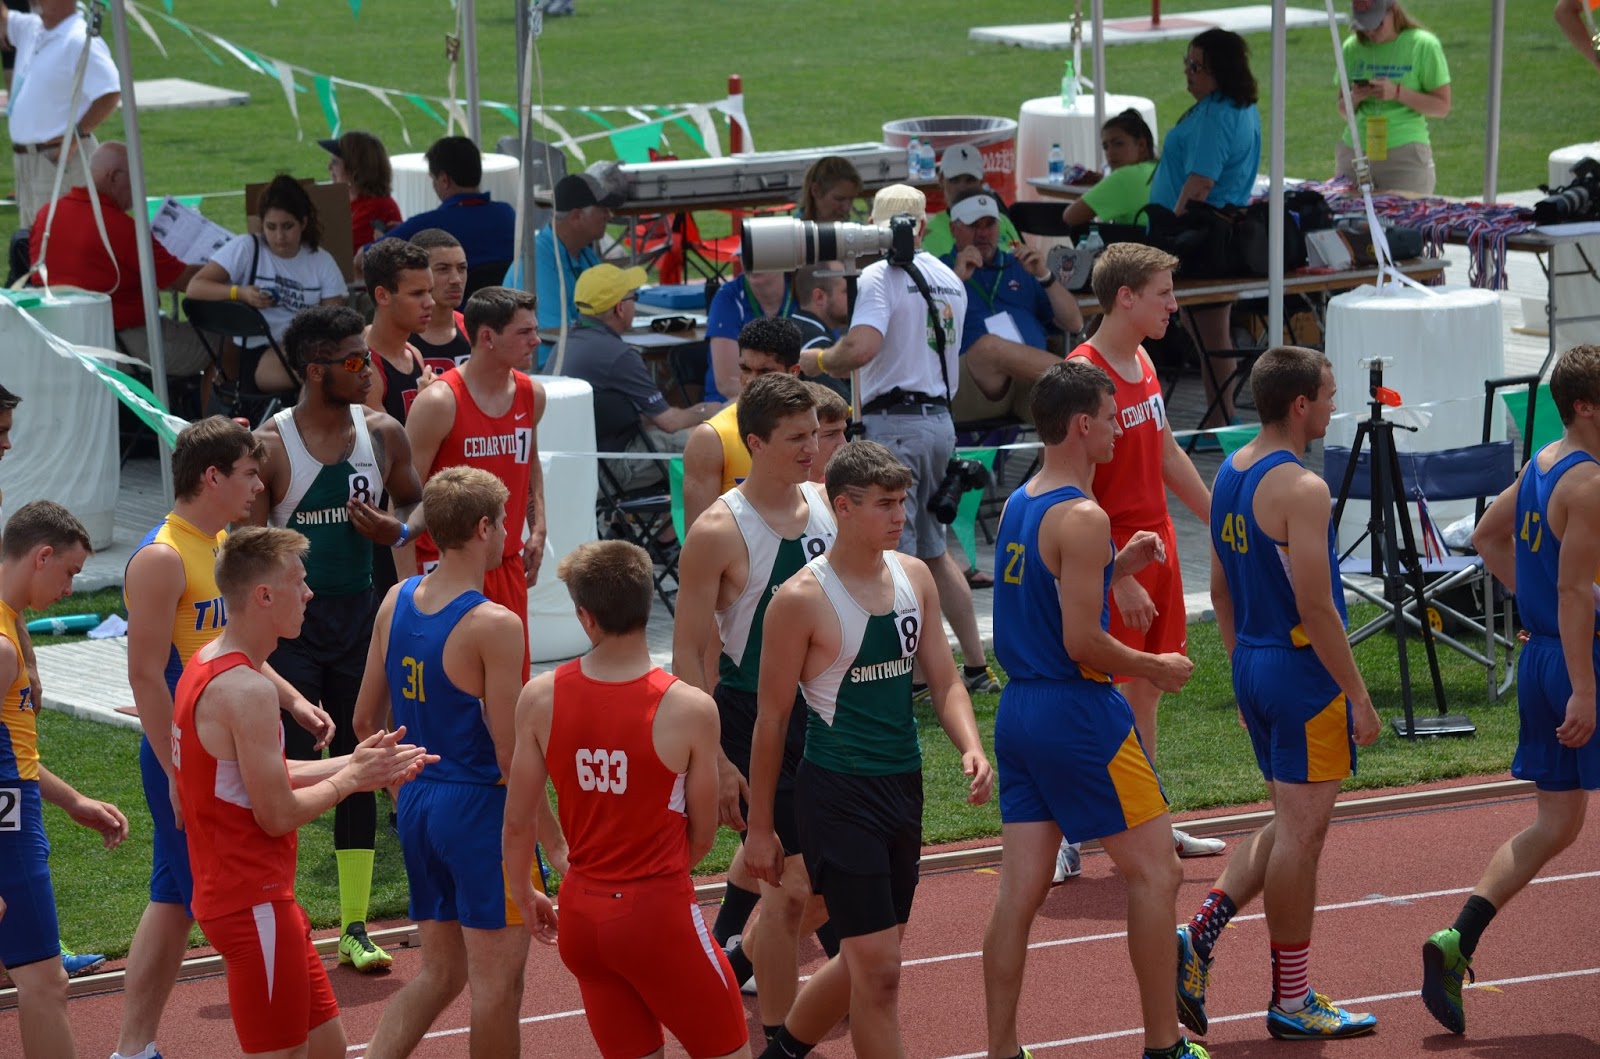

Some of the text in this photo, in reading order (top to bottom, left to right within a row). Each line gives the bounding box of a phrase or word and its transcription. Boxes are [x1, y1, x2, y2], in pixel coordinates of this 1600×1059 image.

[1153, 397, 1163, 428] 1
[518, 431, 526, 462] 1
[352, 475, 371, 503] 8
[1220, 512, 1249, 554] 49
[1520, 510, 1542, 553] 47
[901, 615, 918, 653] 8
[402, 655, 426, 703] 31
[575, 748, 628, 795] 633
[0, 791, 16, 828] 2
